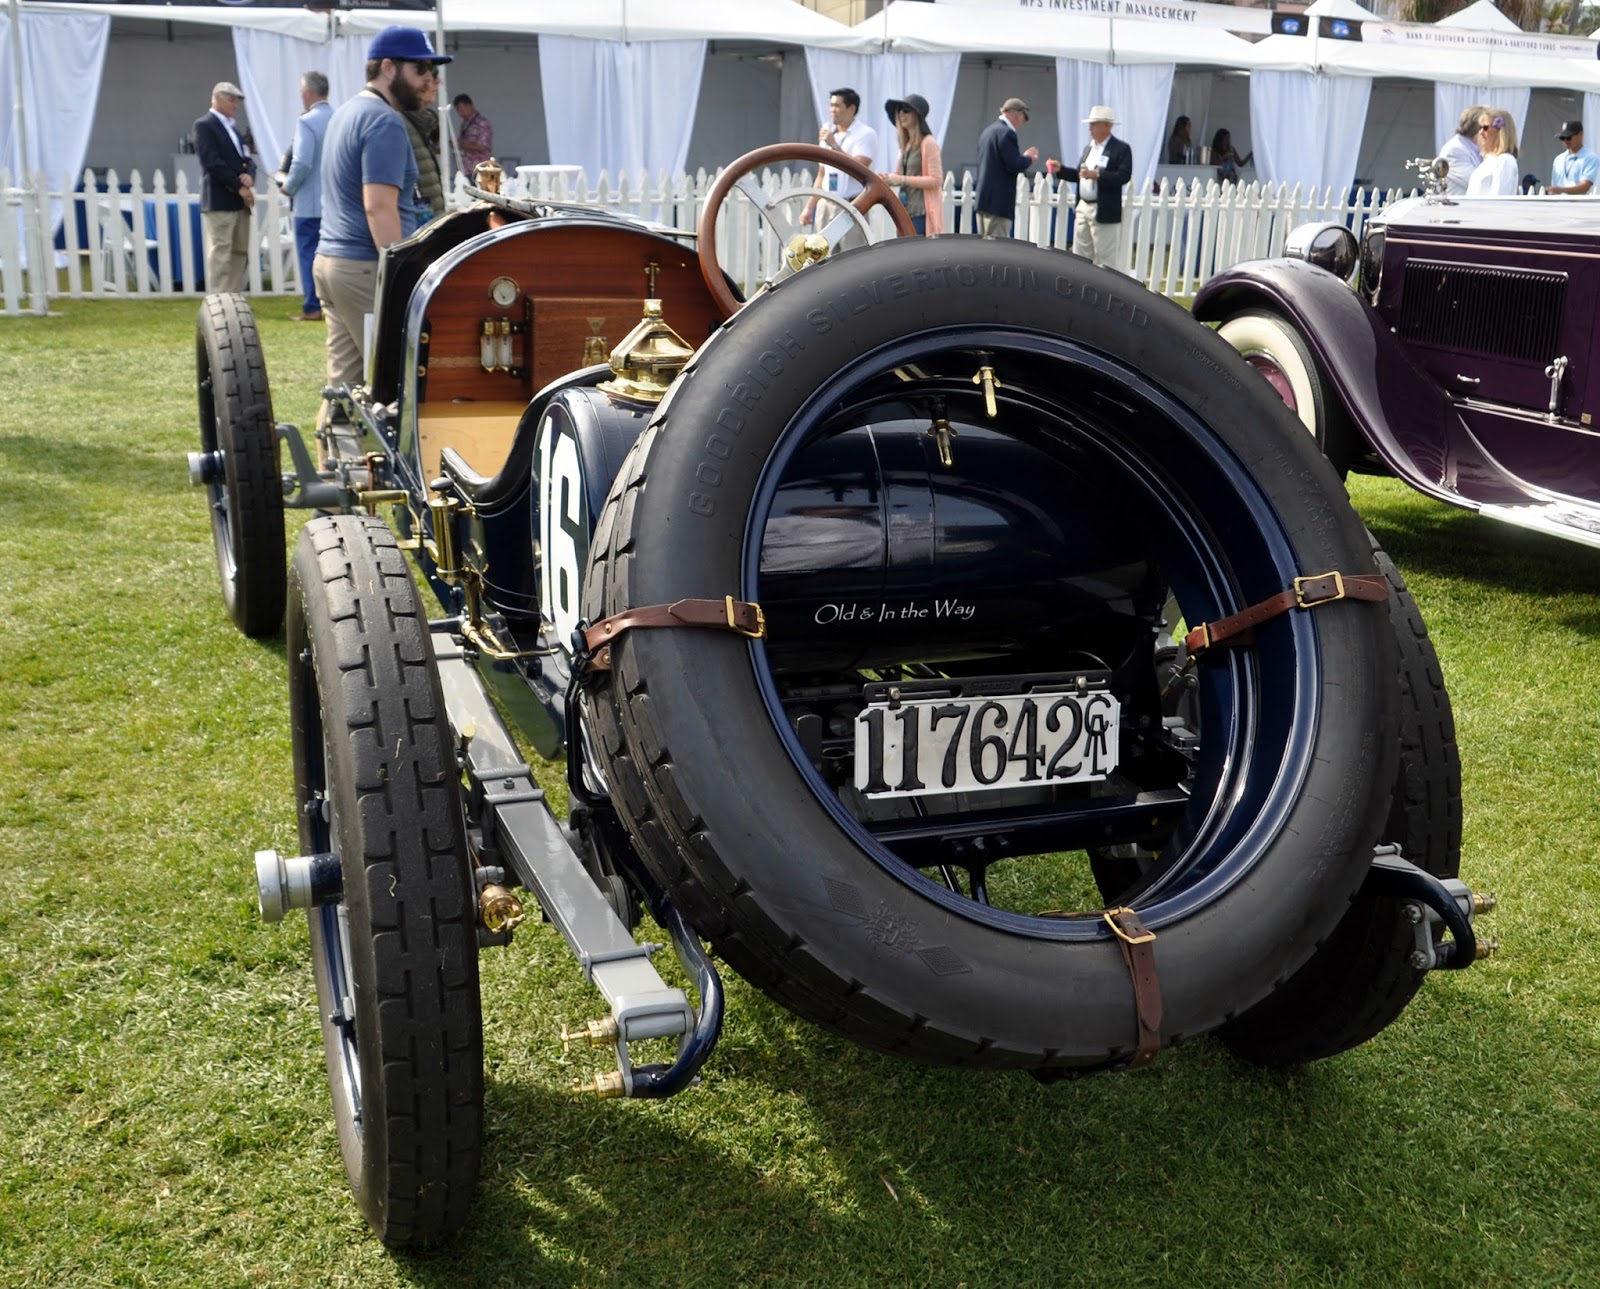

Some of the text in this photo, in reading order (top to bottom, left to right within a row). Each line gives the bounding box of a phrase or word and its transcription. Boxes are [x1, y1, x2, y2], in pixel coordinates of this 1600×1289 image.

[1050, 0, 1120, 12] INVESTMENT
[1126, 3, 1197, 22] MANAGEMENT
[1434, 34, 1464, 43] SOUTHERN
[1467, 36, 1502, 45] CALIFORNIA
[1510, 40, 1537, 49] HARTFORD
[1540, 43, 1556, 51] FUNDS
[689, 263, 1150, 517] GOODRICH SILVERTOWN CORD
[539, 415, 581, 655] 16
[814, 599, 975, 624] Old & In the Way
[859, 697, 1083, 794] 117642
